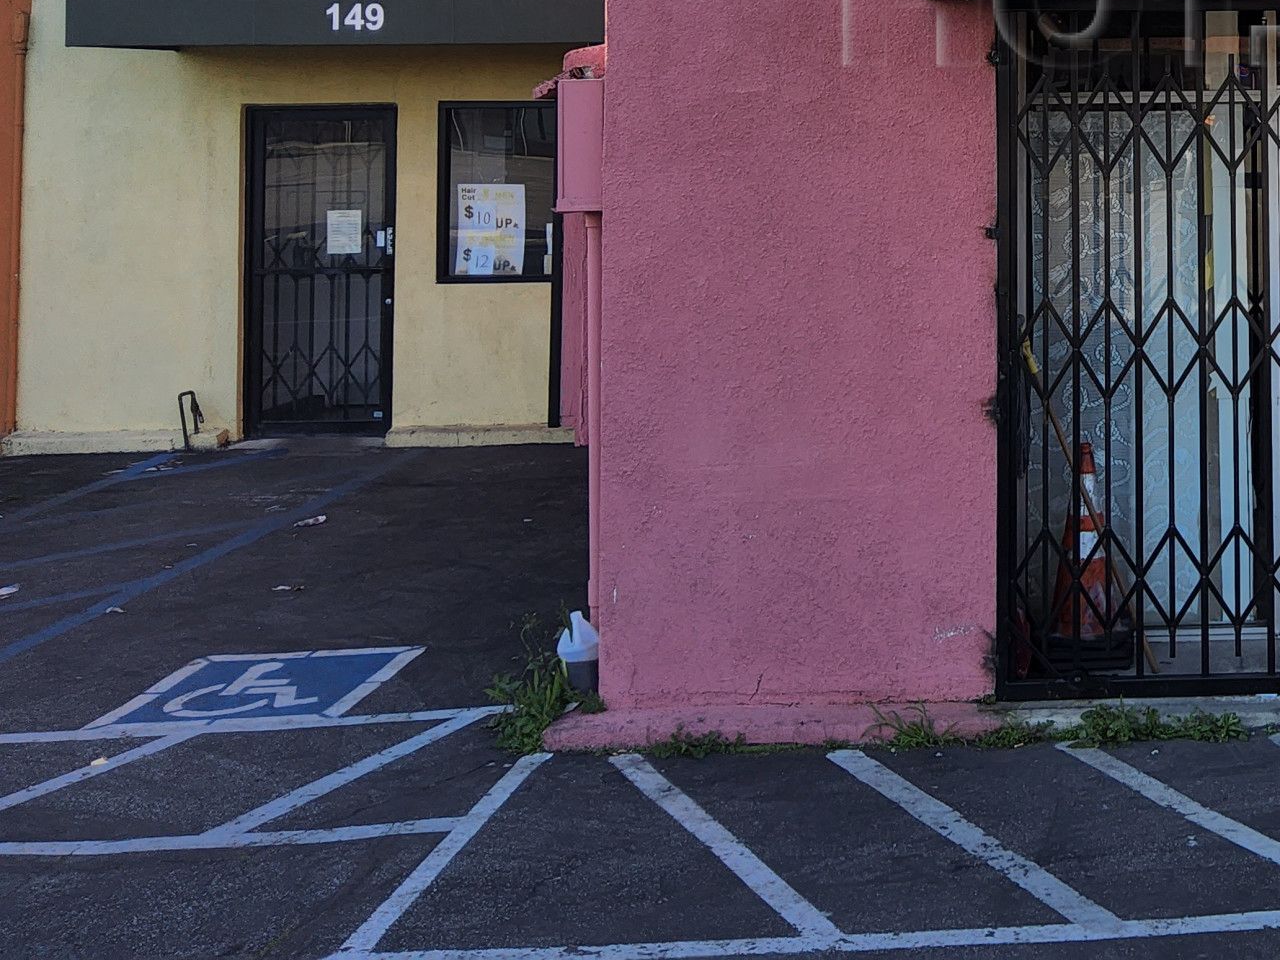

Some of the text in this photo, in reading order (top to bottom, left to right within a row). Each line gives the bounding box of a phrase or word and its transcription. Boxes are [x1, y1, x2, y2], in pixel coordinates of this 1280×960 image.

[325, 2, 385, 31] 149
[496, 218, 513, 229] UP
[494, 259, 511, 271] UP
